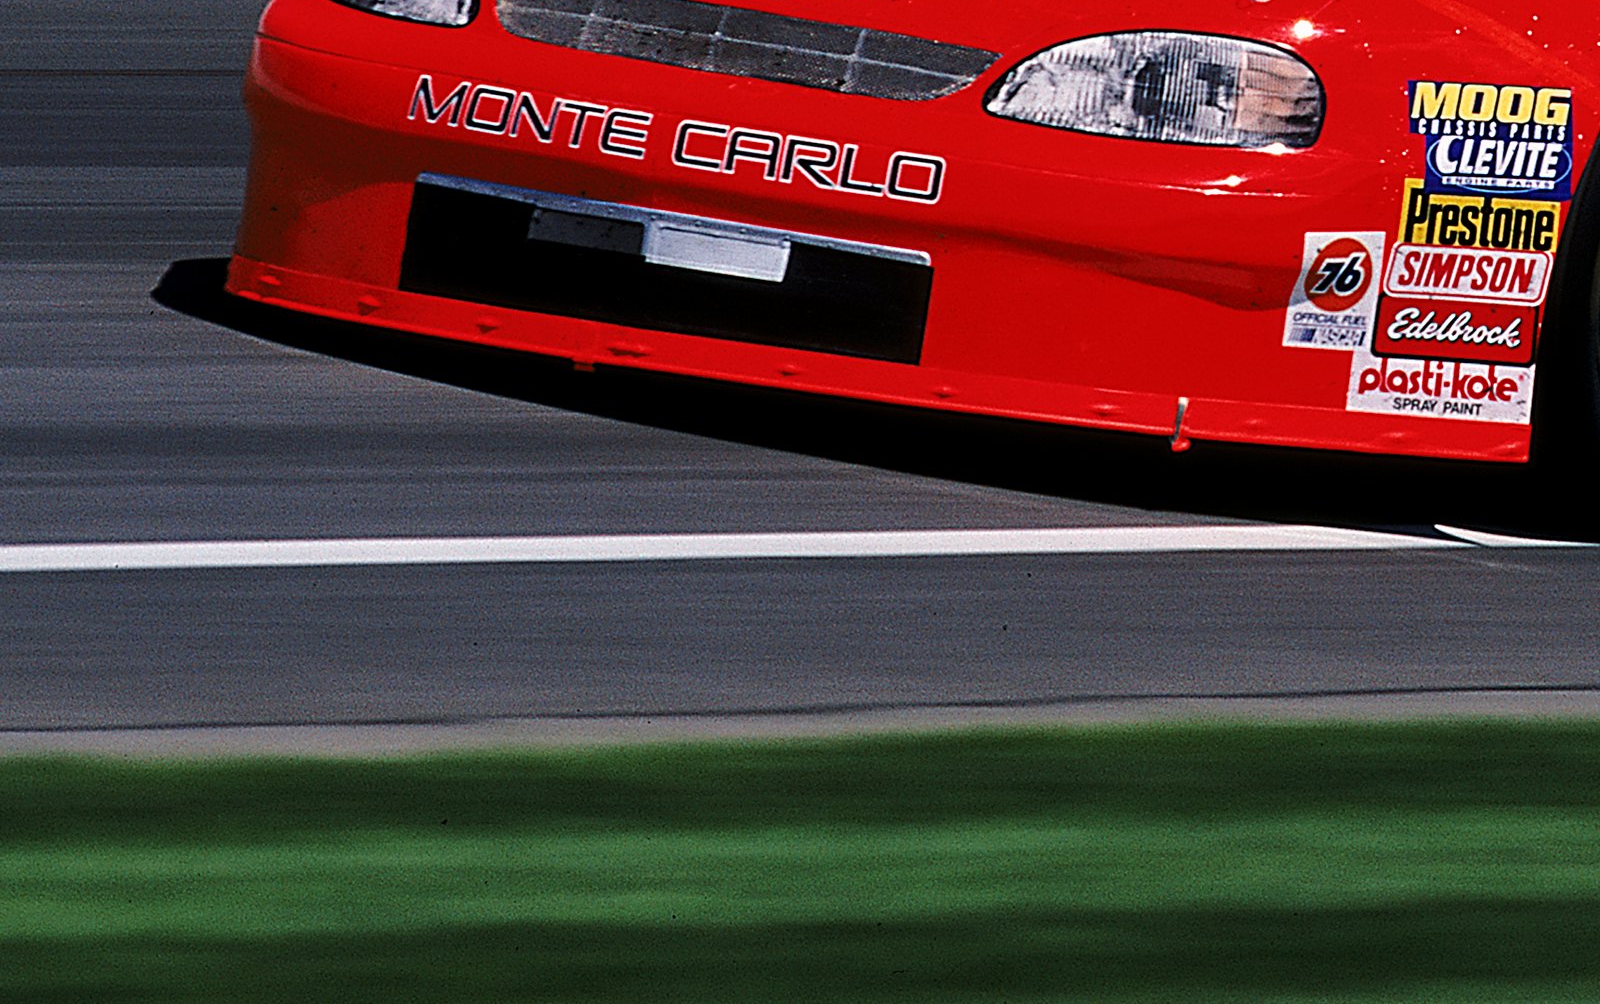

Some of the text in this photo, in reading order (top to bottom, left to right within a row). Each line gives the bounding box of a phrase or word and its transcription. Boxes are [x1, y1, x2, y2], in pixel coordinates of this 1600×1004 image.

[1410, 82, 1572, 126] MOOG
[407, 74, 946, 204] MONTE CARLO
[1418, 119, 1566, 141] CHASSIS PARTS
[1435, 135, 1563, 178] CLEVITE
[1446, 177, 1552, 189] ENGINE PARTS
[1405, 187, 1556, 252] Prestone
[1309, 252, 1367, 296] 76
[1398, 251, 1537, 294] SIMPSON
[1293, 312, 1367, 325] OFFICIAL FUEL
[1386, 307, 1521, 348] Edelbrock
[1358, 357, 1519, 402] plasti-kote
[1393, 397, 1483, 415] SPRAY PAINT
